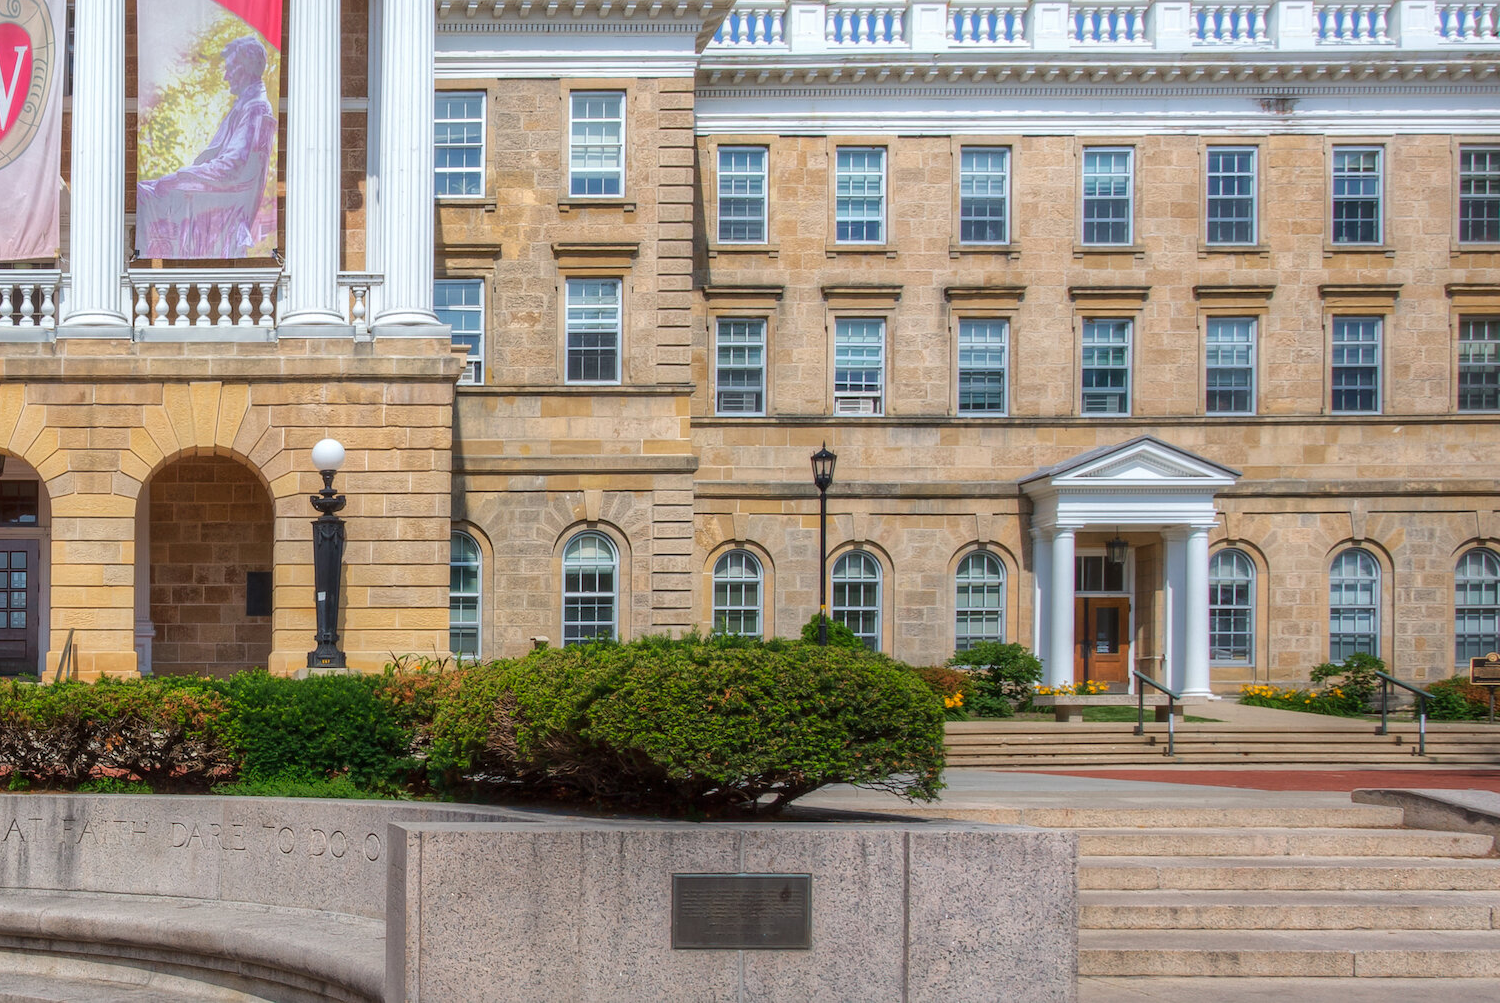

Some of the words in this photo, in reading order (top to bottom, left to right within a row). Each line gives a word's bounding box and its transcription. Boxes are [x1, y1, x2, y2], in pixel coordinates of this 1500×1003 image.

[60, 819, 149, 846] FAITH
[170, 822, 248, 852] DARE
[261, 825, 296, 854] TO
[308, 828, 348, 859] DO
